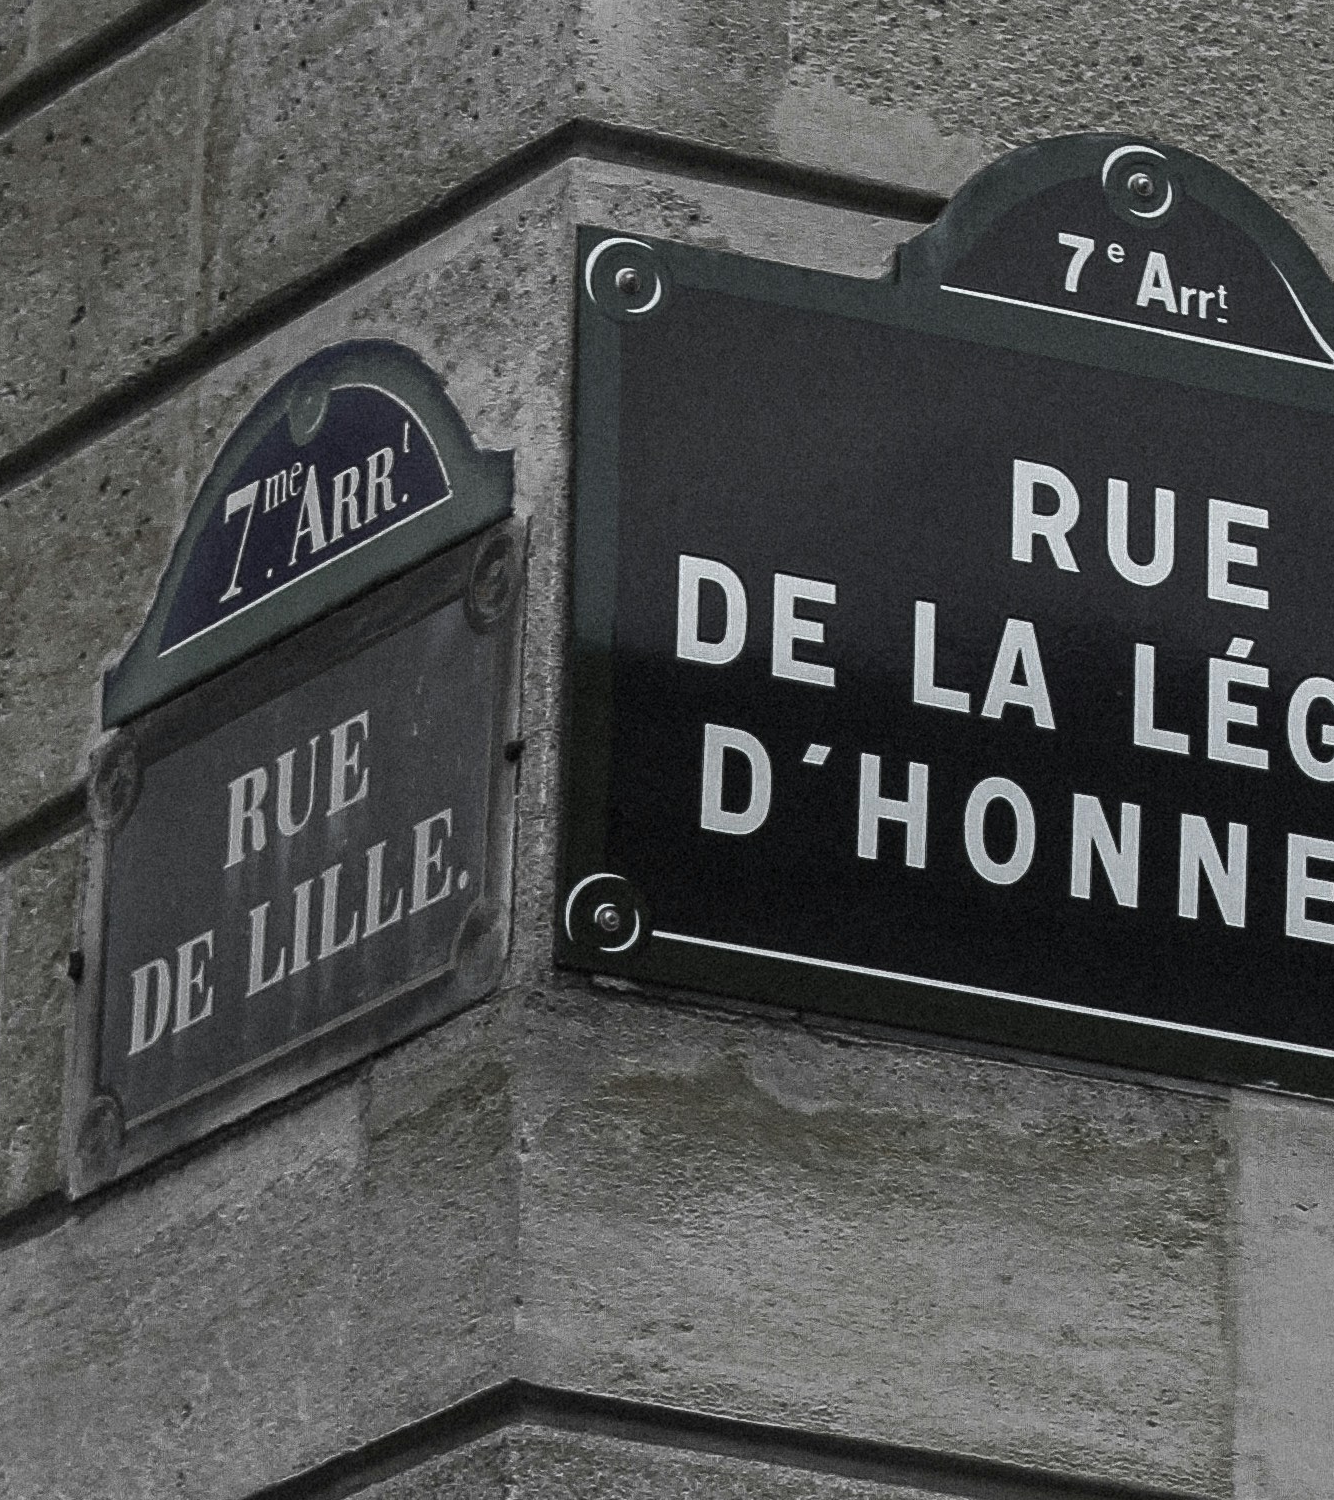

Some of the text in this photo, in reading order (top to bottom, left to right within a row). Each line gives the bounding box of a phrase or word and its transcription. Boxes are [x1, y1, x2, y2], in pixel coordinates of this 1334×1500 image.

[1010, 456, 1271, 610] RUE
[674, 551, 838, 688] DE
[911, 598, 1057, 731] LA
[222, 709, 372, 870] RUE
[126, 806, 471, 1057] DE LILLE.
